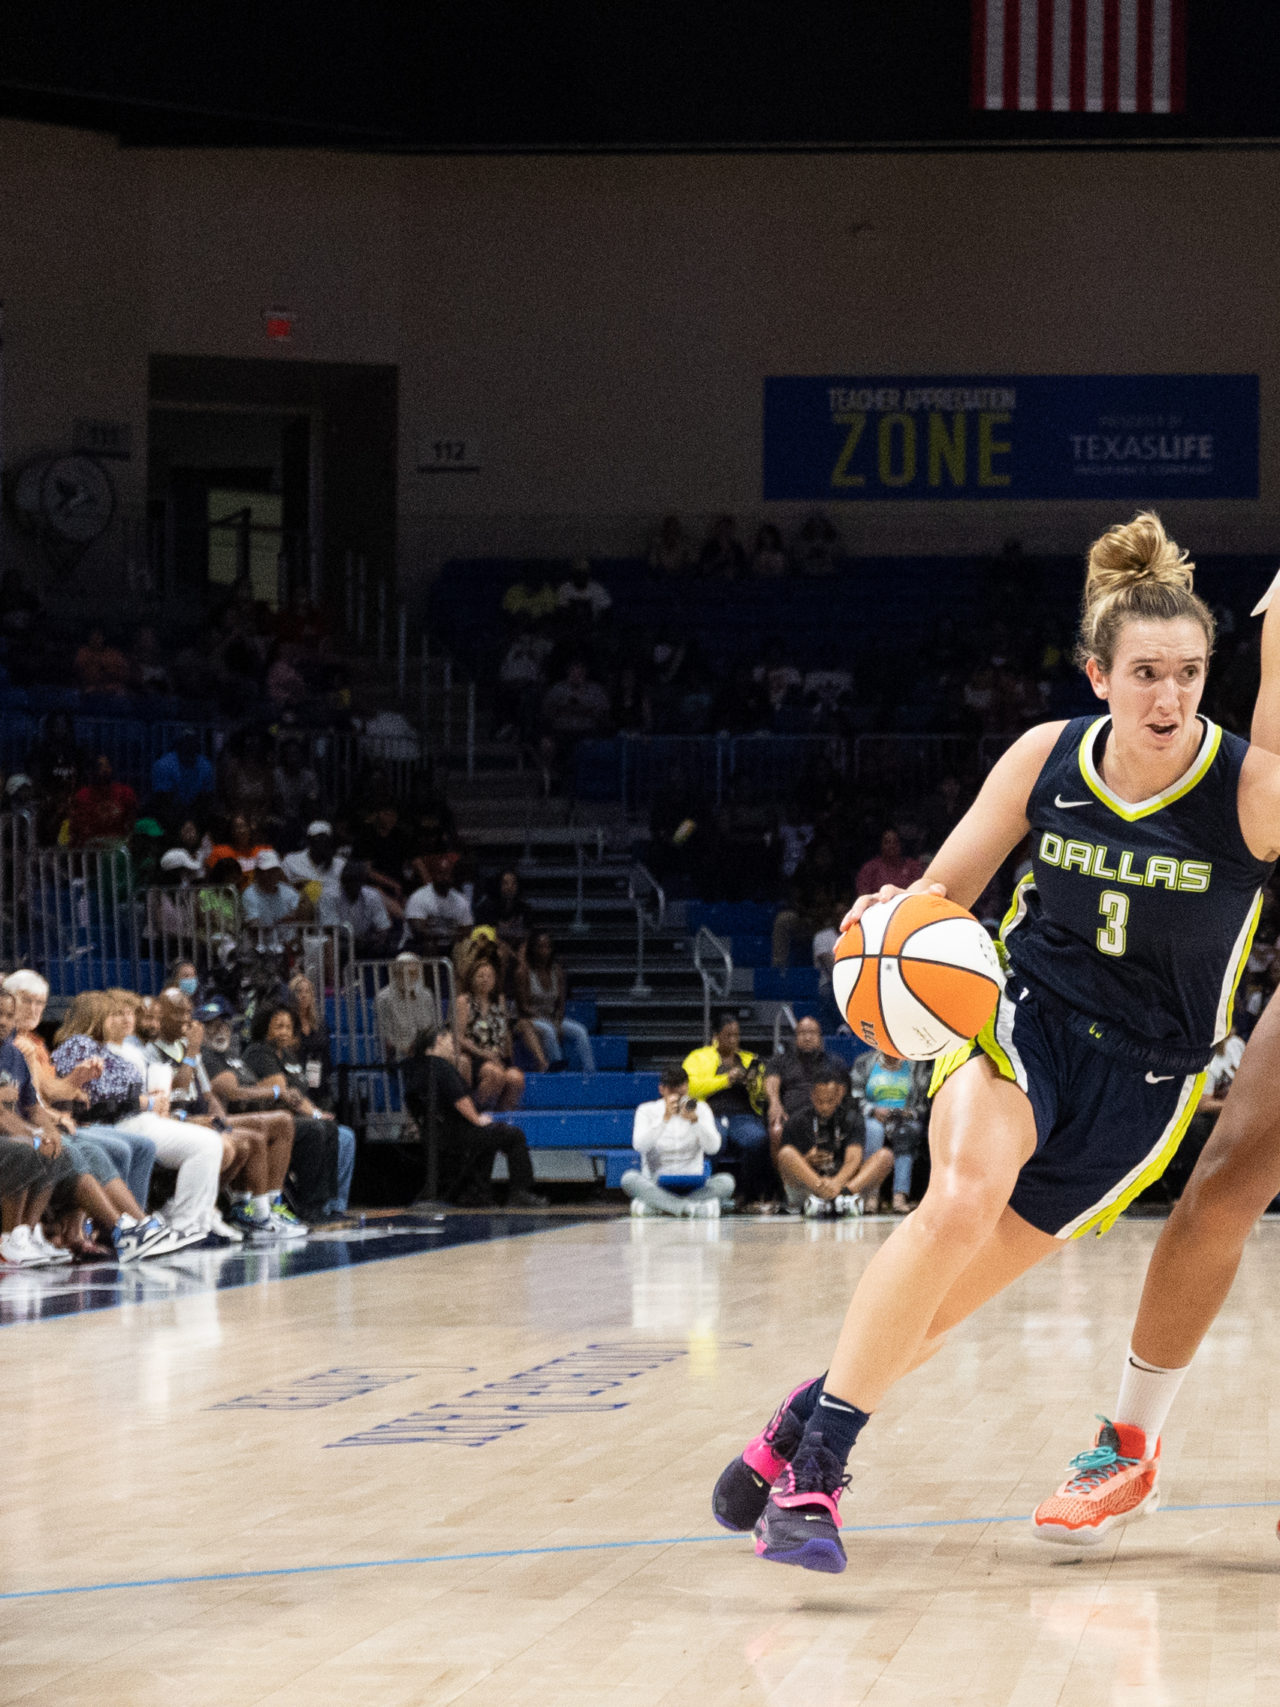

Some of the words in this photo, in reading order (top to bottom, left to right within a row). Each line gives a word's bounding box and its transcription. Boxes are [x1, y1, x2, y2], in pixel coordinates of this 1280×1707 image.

[434, 442, 465, 460] 112
[831, 413, 1012, 486] ZONE
[1070, 434, 1213, 460] TEXASLIFE
[1038, 832, 1213, 893] DALLAS
[1096, 889, 1130, 957] 3
